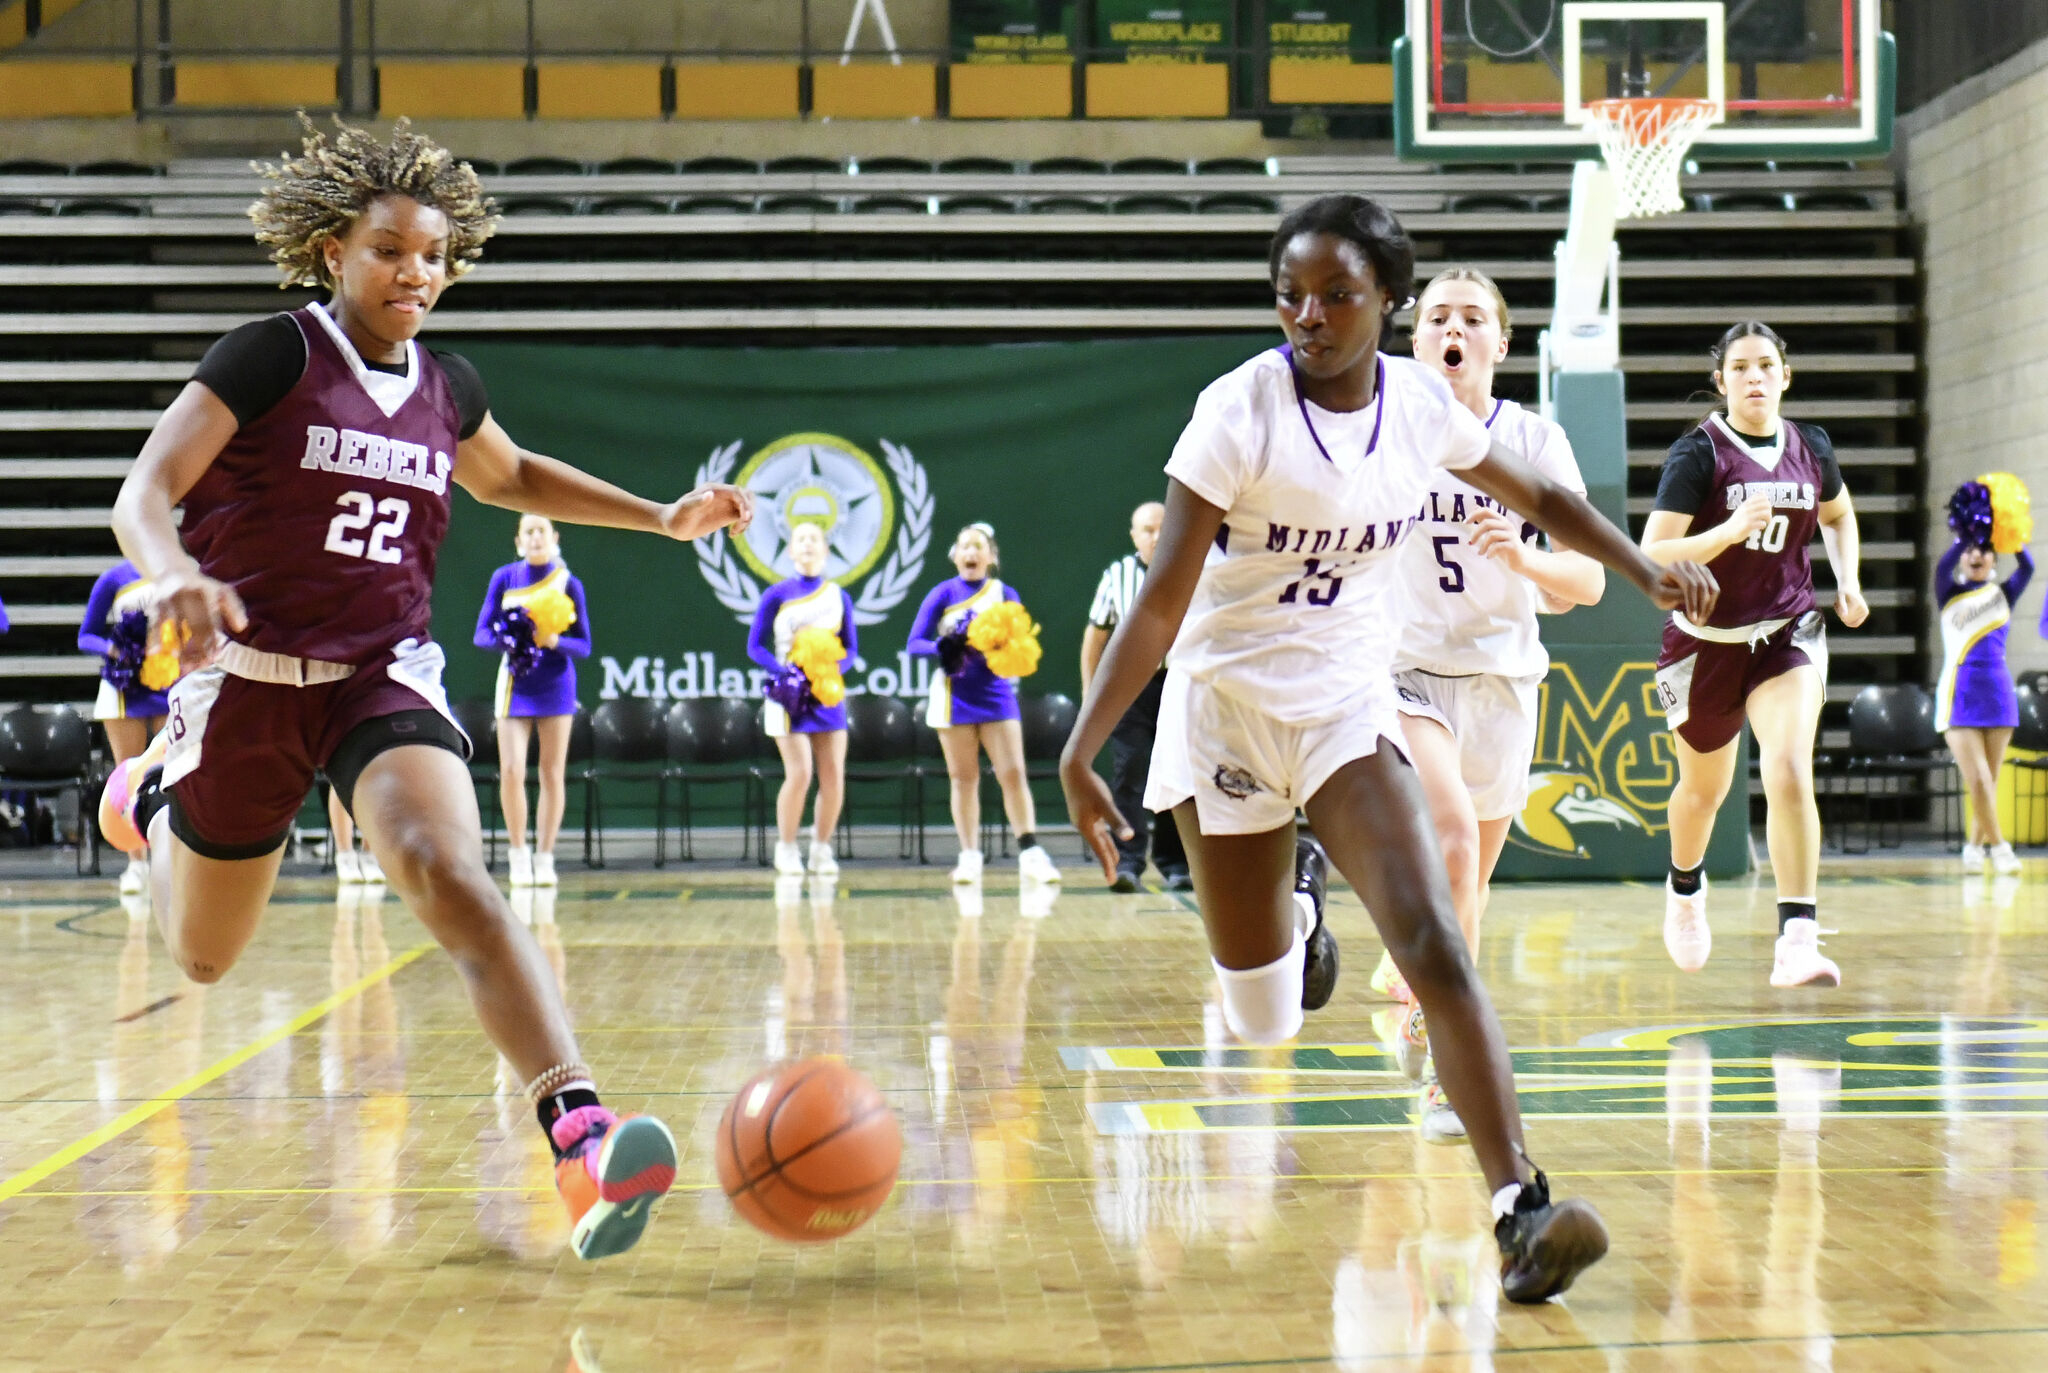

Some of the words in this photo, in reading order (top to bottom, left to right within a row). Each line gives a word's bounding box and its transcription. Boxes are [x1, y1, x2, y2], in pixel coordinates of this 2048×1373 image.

[1110, 23, 1221, 41] WORKPLACE
[1270, 23, 1351, 41] STUDENT
[300, 425, 451, 496] REBELS
[324, 490, 411, 565] 22
[1432, 536, 1465, 592] 5
